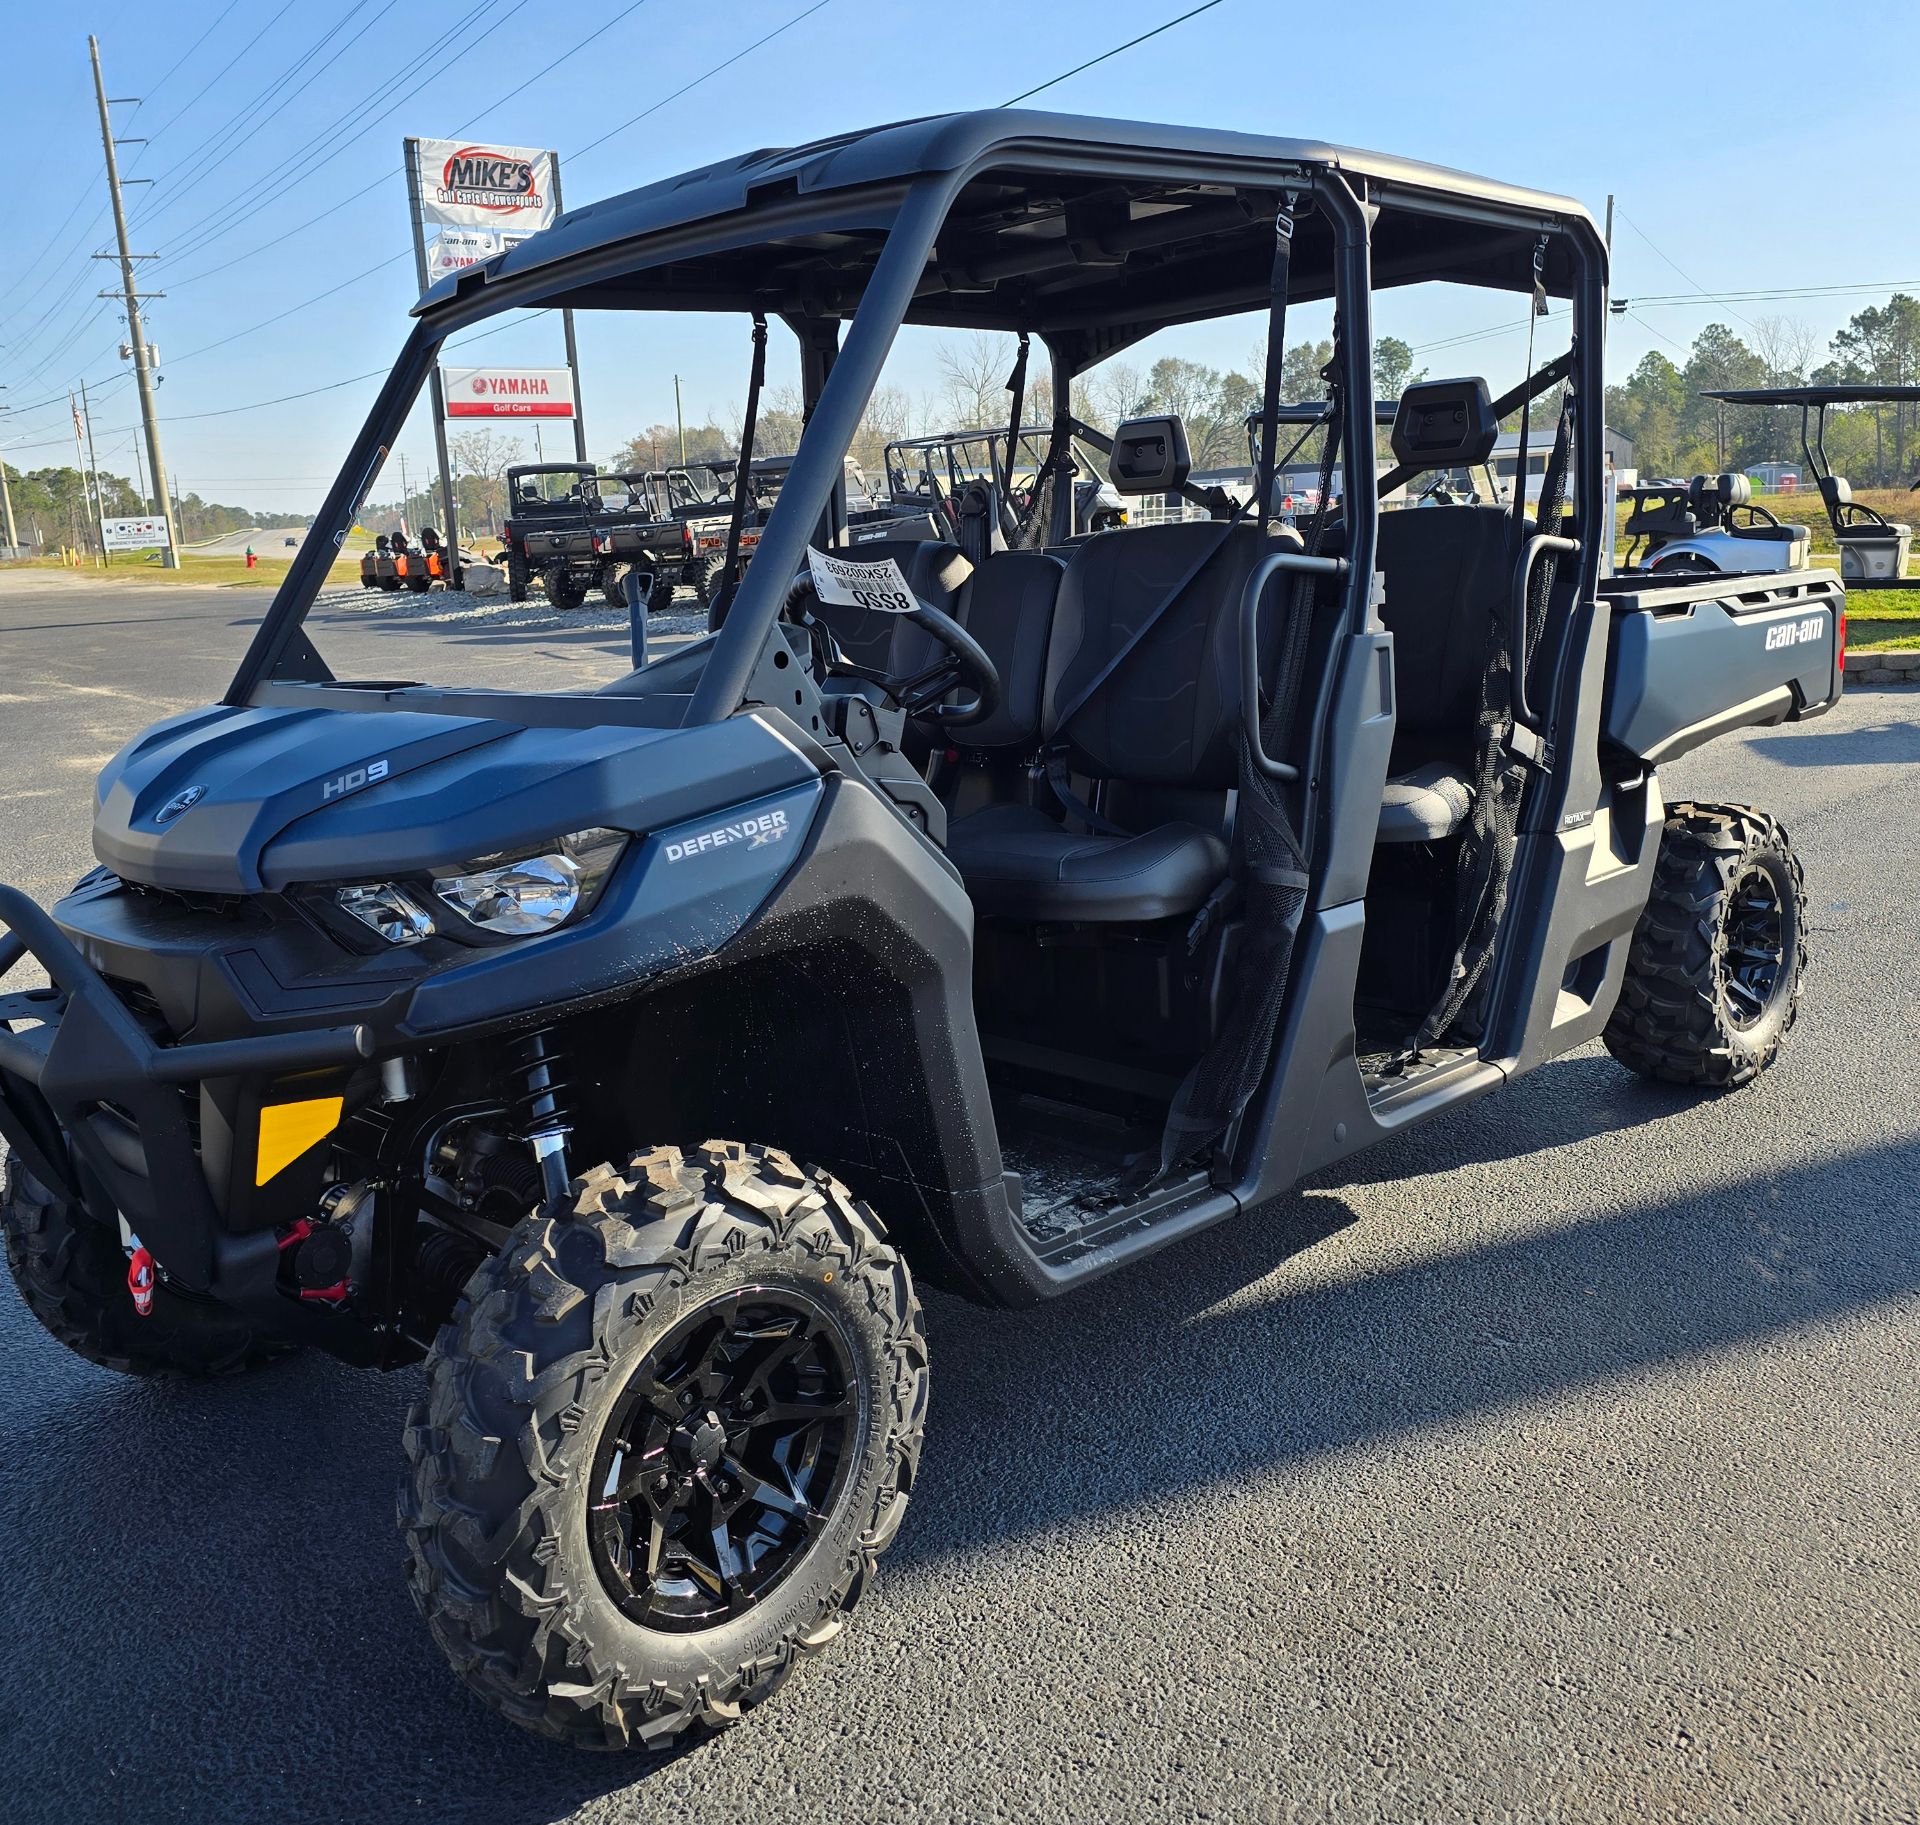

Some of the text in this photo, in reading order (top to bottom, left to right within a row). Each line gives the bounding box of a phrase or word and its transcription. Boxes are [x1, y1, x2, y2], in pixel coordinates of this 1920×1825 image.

[447, 158, 532, 193] MIKE'S
[437, 189, 543, 209] Golf Carts & Powersports
[444, 237, 478, 246] an-am
[488, 378, 549, 395] YAMAHA
[493, 404, 532, 412] Golf Cars
[700, 537, 721, 546] BAD
[825, 560, 892, 579] 2SK002693
[1764, 616, 1824, 651] can-am
[323, 759, 389, 799] HD9
[665, 810, 787, 862] DEFENDER
[751, 825, 789, 847] XT
